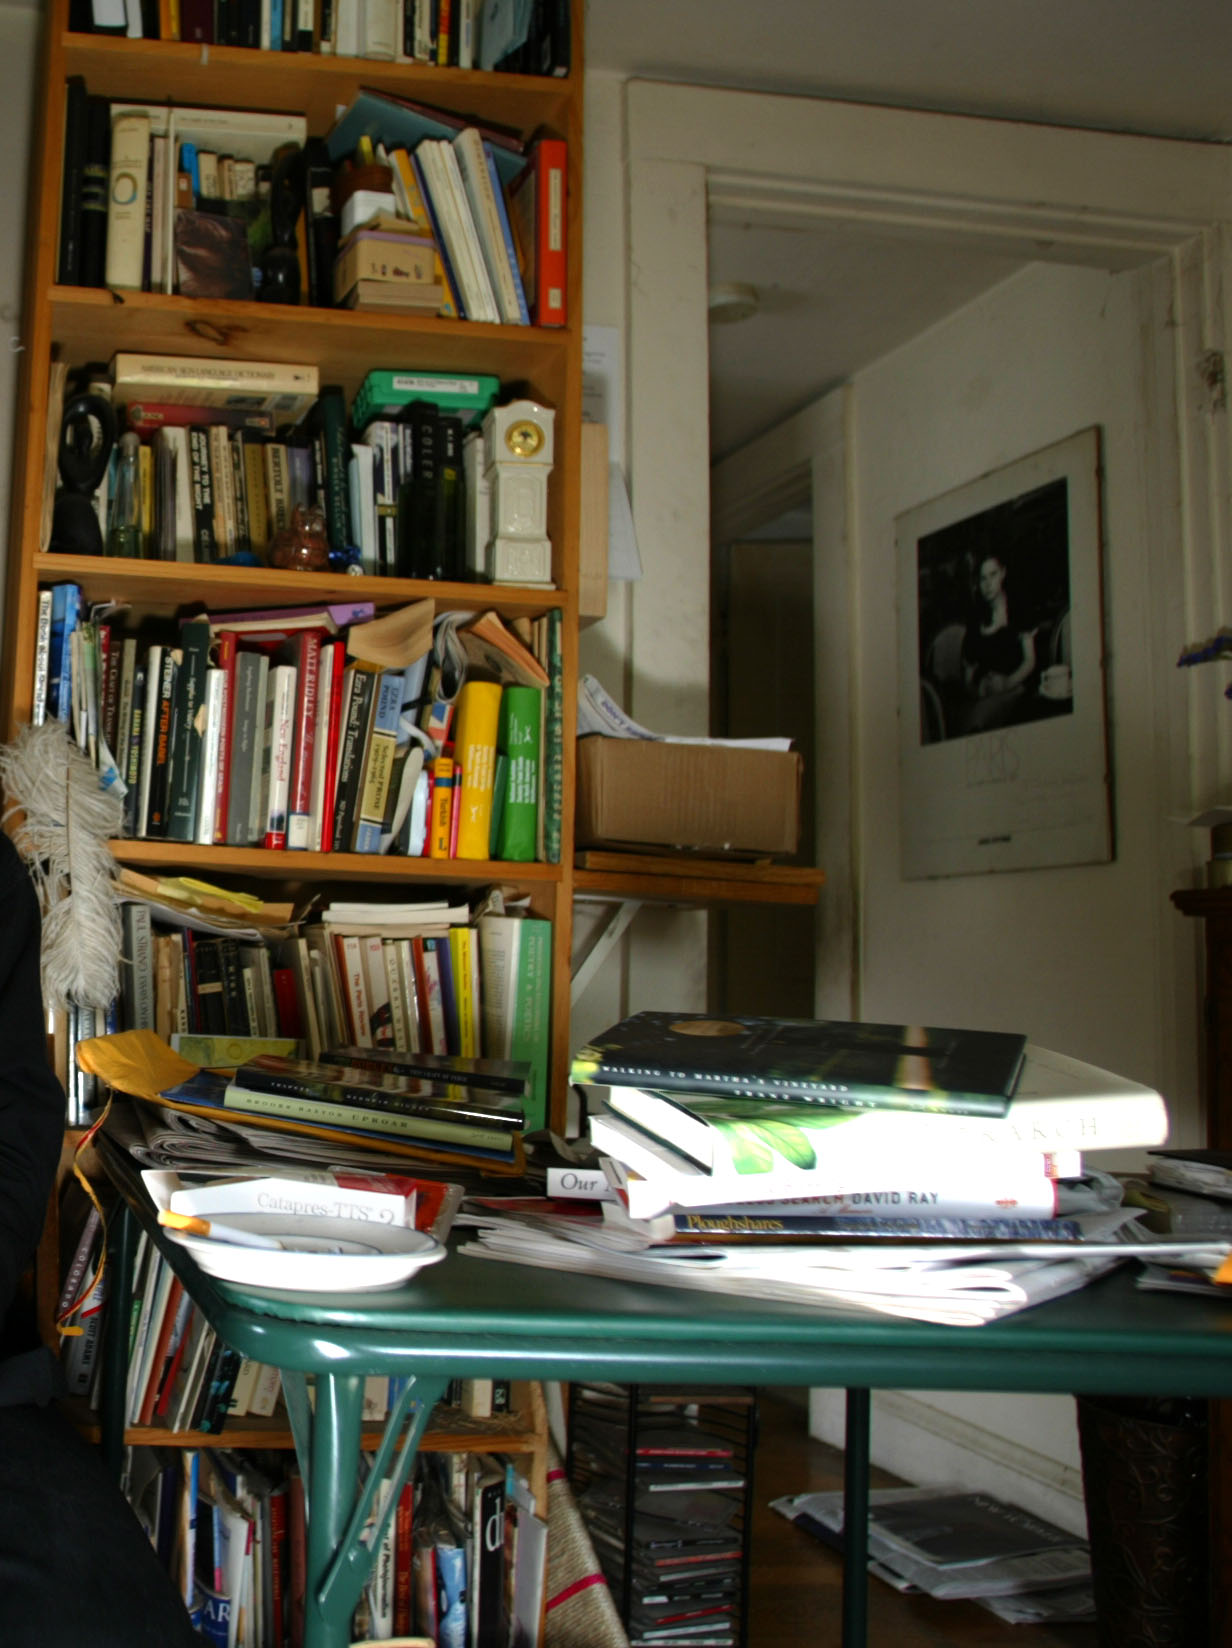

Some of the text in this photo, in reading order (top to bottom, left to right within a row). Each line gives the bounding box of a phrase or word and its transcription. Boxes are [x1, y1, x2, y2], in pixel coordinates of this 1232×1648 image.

[190, 431, 203, 510] END OF THE NIGHT
[198, 432, 211, 504] JOURNEY TO THE
[272, 448, 283, 493] BERTOLT
[304, 638, 318, 717] MATT RIDLEY
[156, 656, 173, 766] STEINER AFTER BABEL
[378, 684, 391, 718] POUND
[388, 686, 400, 711] EZRA
[340, 673, 366, 783] Ezra Pound: Translations
[274, 719, 289, 782] New England
[372, 744, 390, 811] Selected PROSE
[439, 798, 449, 827] Turkish
[137, 935, 148, 972] STRAND
[352, 973, 367, 1037] The Paris Review
[602, 1064, 849, 1092] WALKING TO MARTHA'S VINEYARD
[734, 1089, 877, 1108] FRANZ WRIGHT
[352, 1114, 408, 1128] UPROAR
[559, 1173, 599, 1192] Our
[851, 1192, 901, 1206] DAVID
[909, 1193, 938, 1206] RAY
[257, 1192, 370, 1222] Catapres-TTS
[687, 1215, 784, 1231] Ploughshares
[61, 1247, 89, 1308] COLORADO
[81, 1340, 96, 1365] ADAMS
[380, 1553, 390, 1619] Photojournalism
